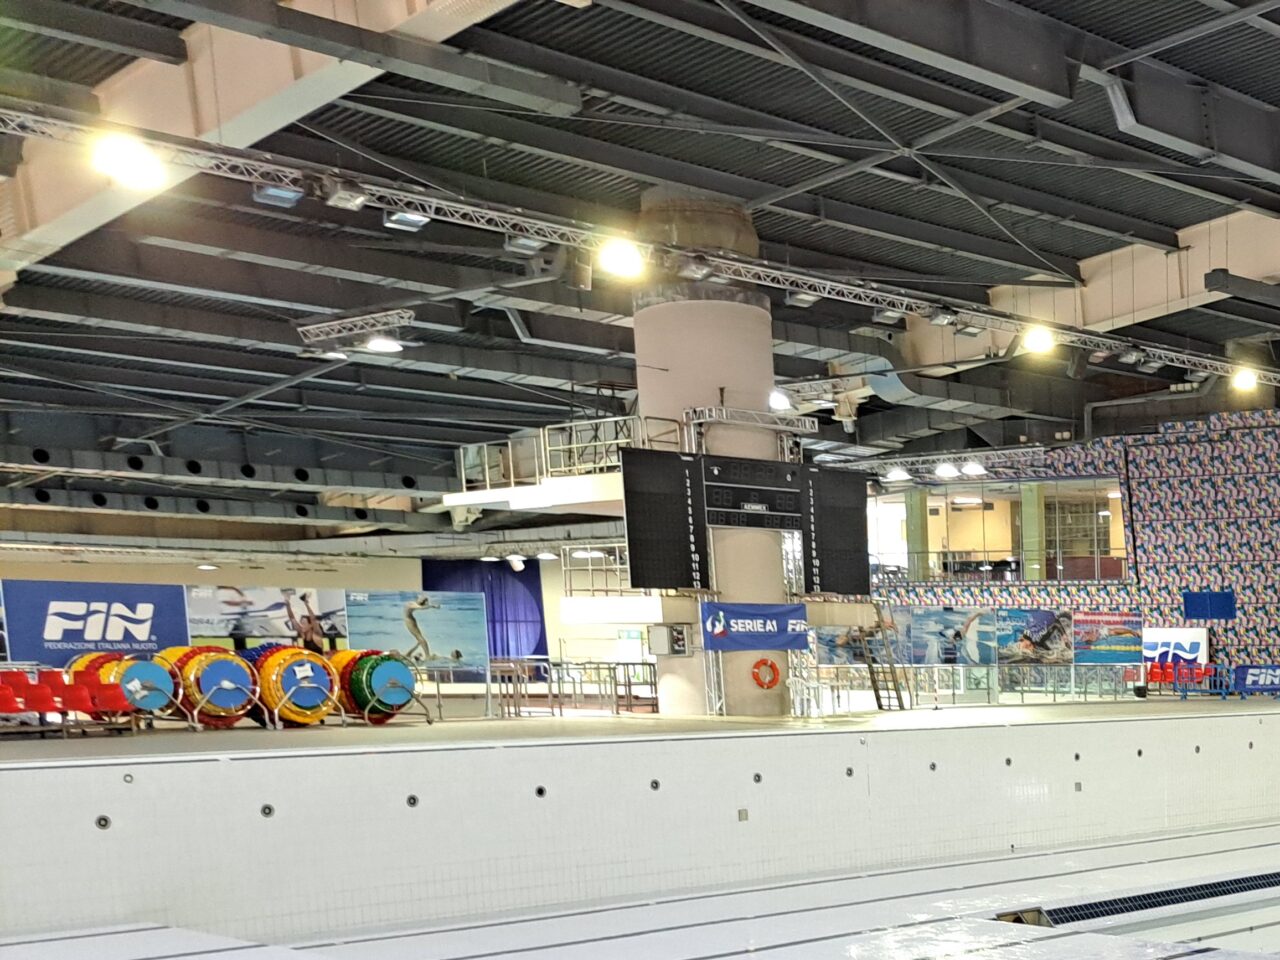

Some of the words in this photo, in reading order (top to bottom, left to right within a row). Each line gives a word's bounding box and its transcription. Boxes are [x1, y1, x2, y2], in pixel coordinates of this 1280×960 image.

[691, 553, 700, 562] 10
[691, 562, 699, 571] 11
[692, 571, 700, 580] 12
[43, 601, 155, 641] FIN
[730, 619, 765, 632] SERIE
[44, 642, 96, 650] FEDERAZIONE
[97, 642, 131, 650] ITALIANA
[132, 643, 158, 651] NUOTO
